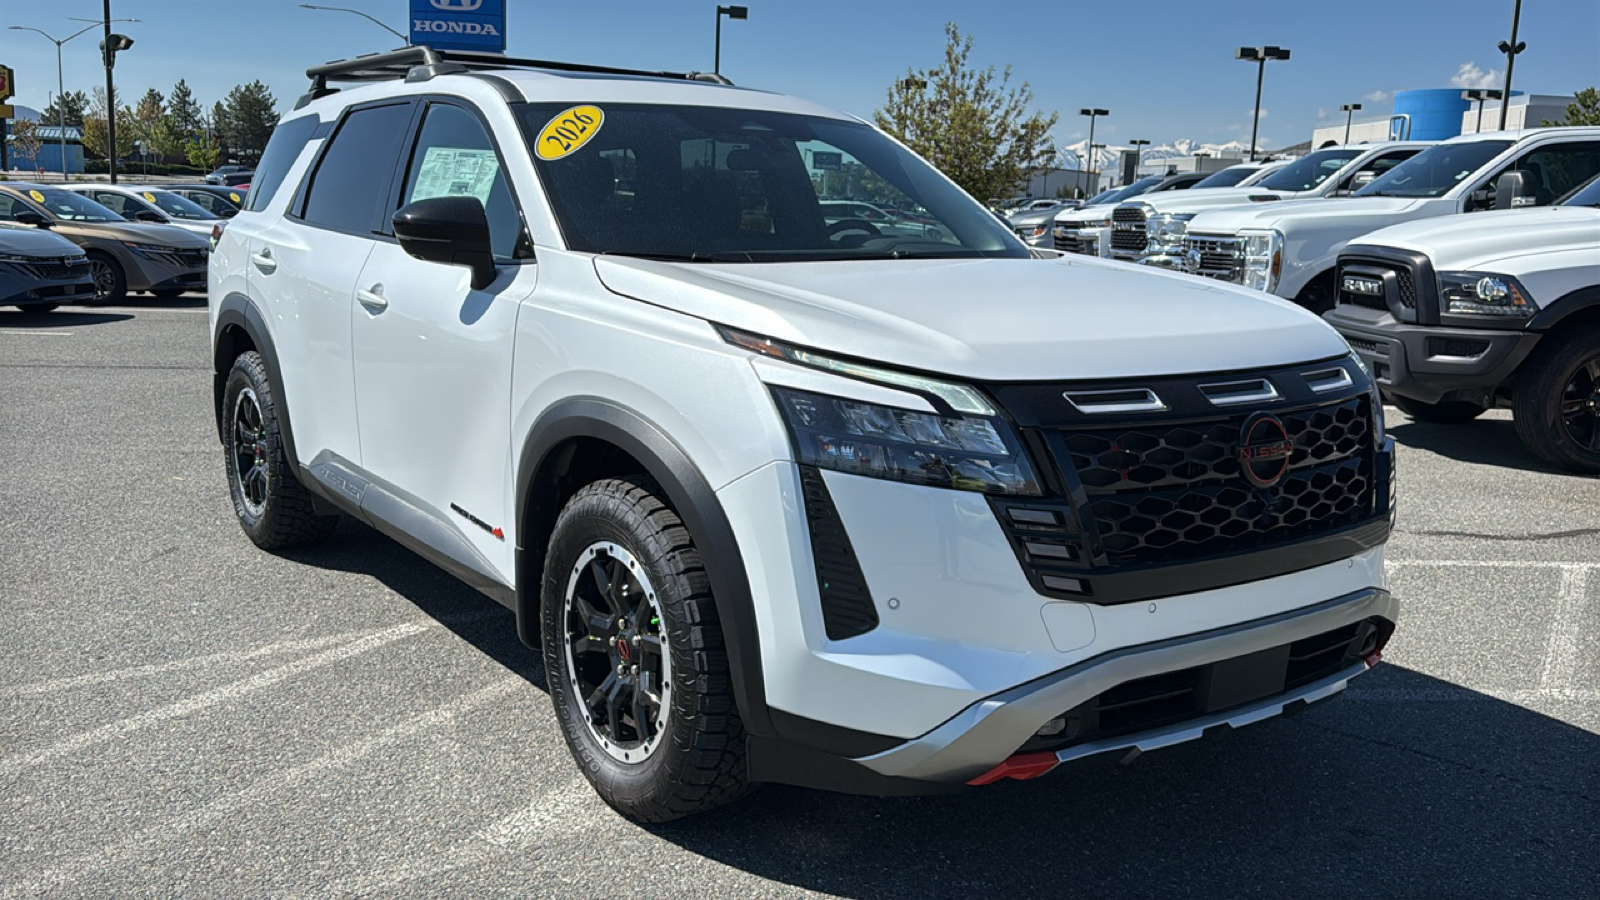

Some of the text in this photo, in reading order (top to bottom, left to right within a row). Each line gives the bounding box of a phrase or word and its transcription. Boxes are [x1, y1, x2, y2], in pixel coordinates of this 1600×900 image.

[414, 20, 499, 35] HONDA
[546, 110, 594, 151] 2026
[1344, 280, 1383, 295] RAM
